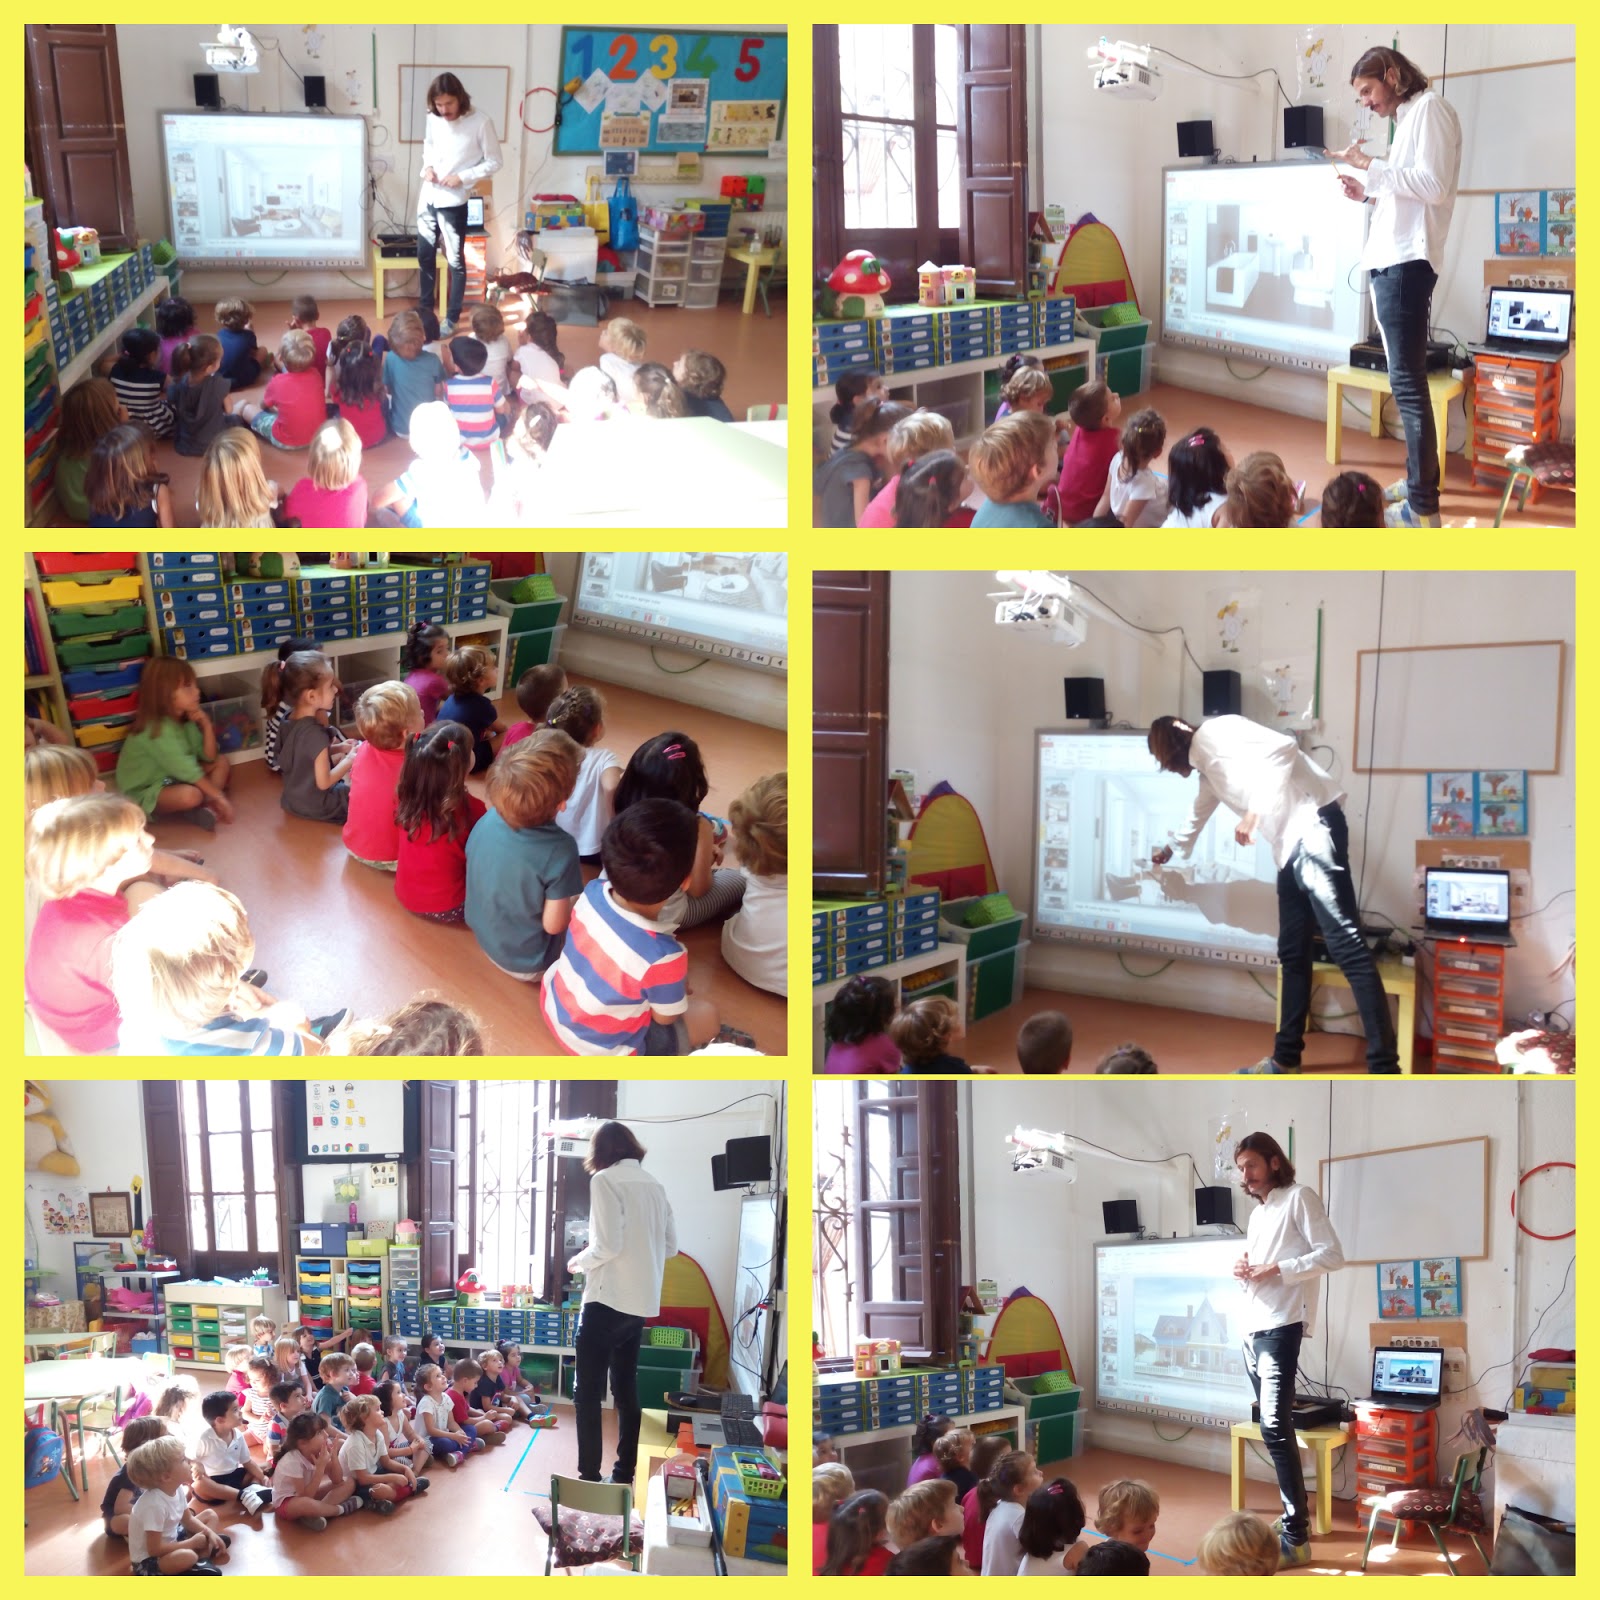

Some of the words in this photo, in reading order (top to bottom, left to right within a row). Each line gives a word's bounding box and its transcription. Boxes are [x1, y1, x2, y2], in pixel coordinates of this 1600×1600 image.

[571, 34, 594, 79] 1
[608, 34, 639, 80] 2
[649, 34, 679, 80] 3
[684, 36, 718, 79] 4
[734, 38, 765, 82] 5
